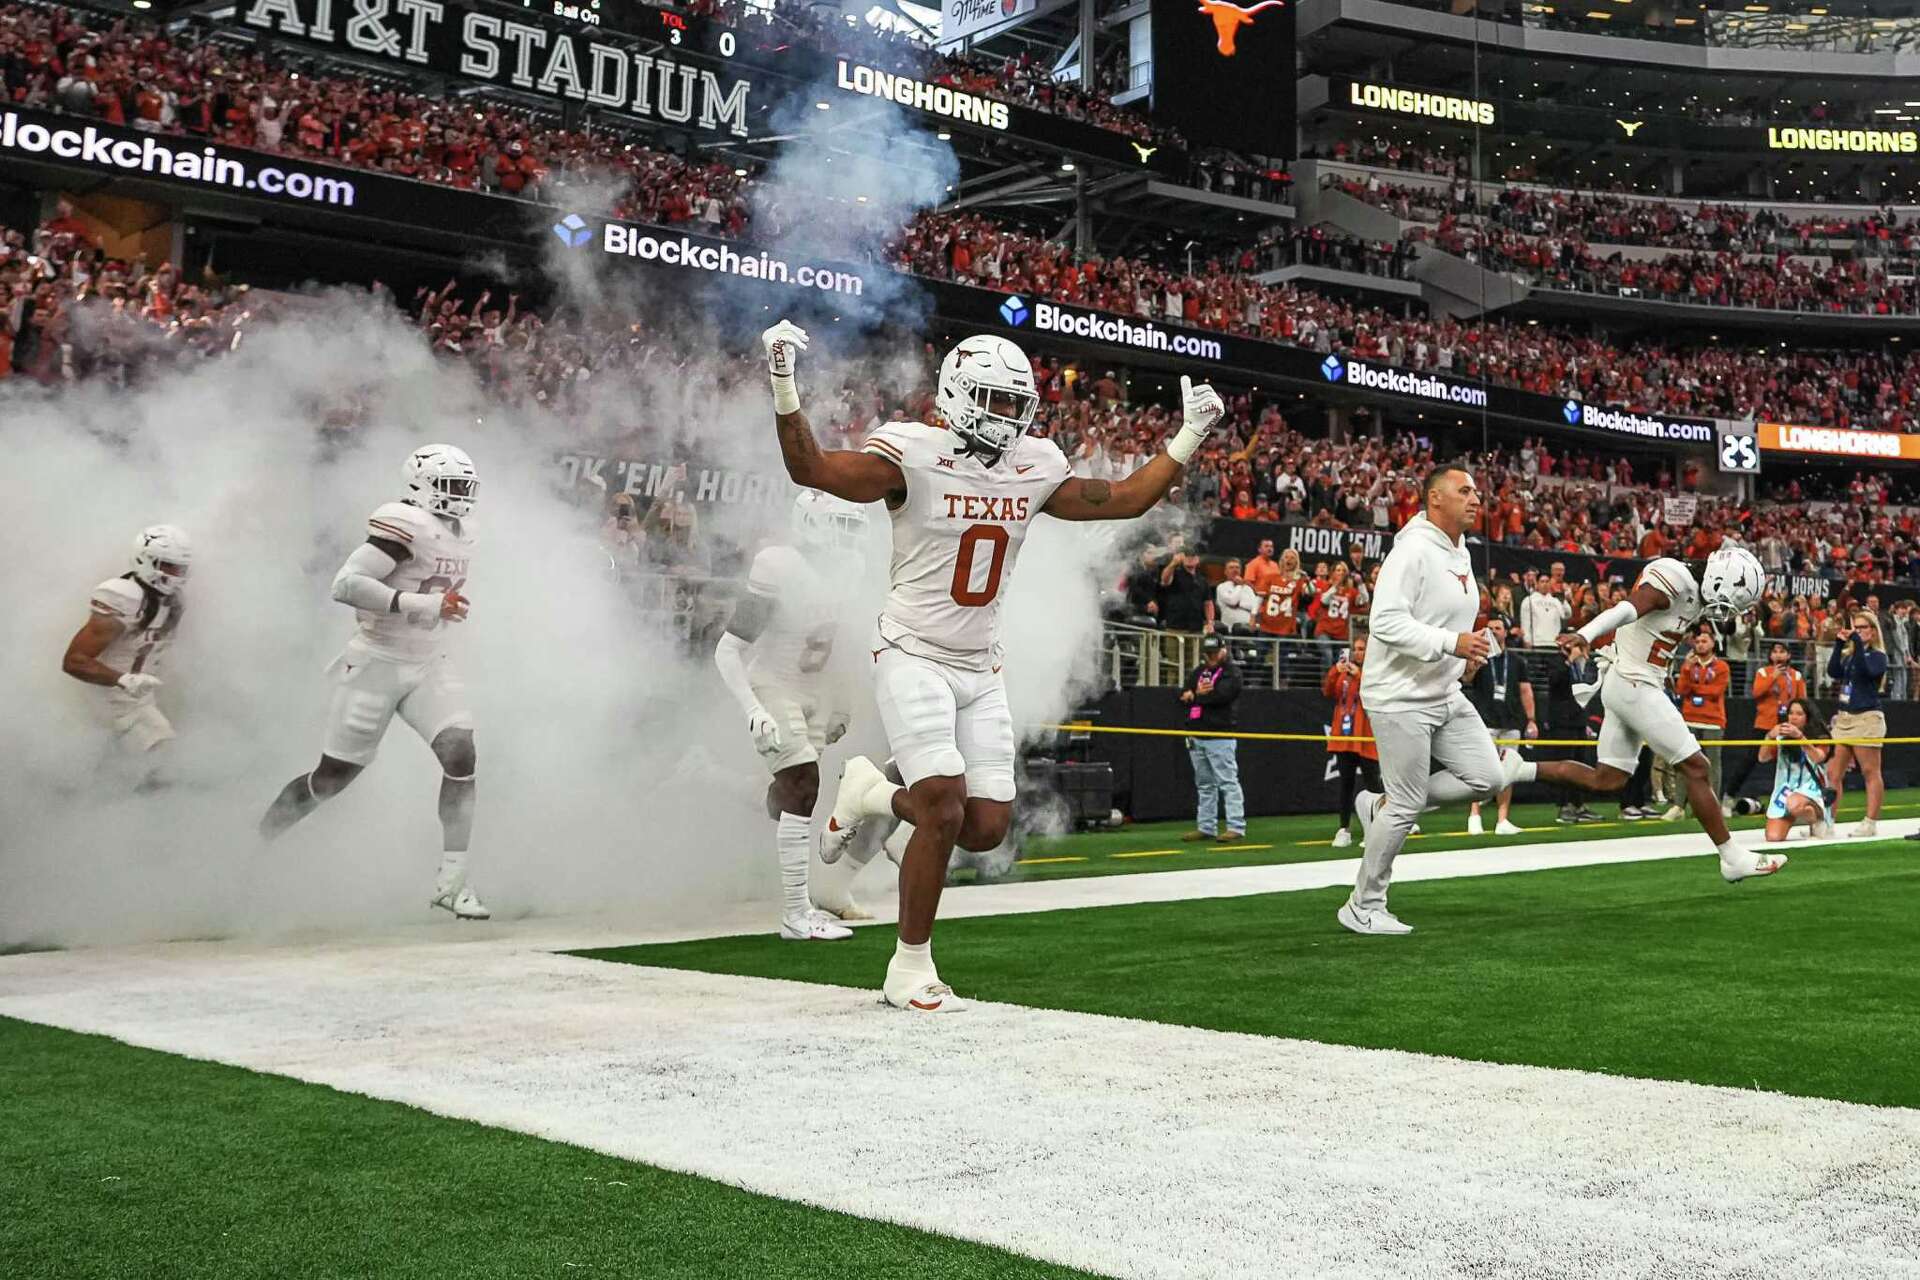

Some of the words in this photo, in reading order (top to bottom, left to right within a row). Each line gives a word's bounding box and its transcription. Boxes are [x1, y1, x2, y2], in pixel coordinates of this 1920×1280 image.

[553, 1, 579, 20] Ball
[580, 9, 600, 26] On
[660, 11, 687, 30] TOL
[670, 28, 682, 45] 3
[719, 32, 736, 57] 0
[460, 12, 751, 137] STADIUM
[837, 61, 1009, 130] LONGHORNS
[1350, 82, 1495, 125] LONGHORNS
[1768, 127, 1918, 152] LONGHORNS
[0, 111, 355, 206] lockchain.com
[603, 223, 863, 296] Blockchain.com
[1035, 303, 1221, 360] Blockchain.com
[1347, 361, 1488, 406] Blockchain.com
[1583, 405, 1711, 441] Blockchain.com
[1779, 426, 1900, 456] LONGHORNS
[944, 493, 1029, 521] TEXAS
[1290, 526, 1344, 556] HOOK
[950, 523, 1010, 608] 0
[1791, 575, 1830, 598] HORNS
[1266, 593, 1293, 617] 64
